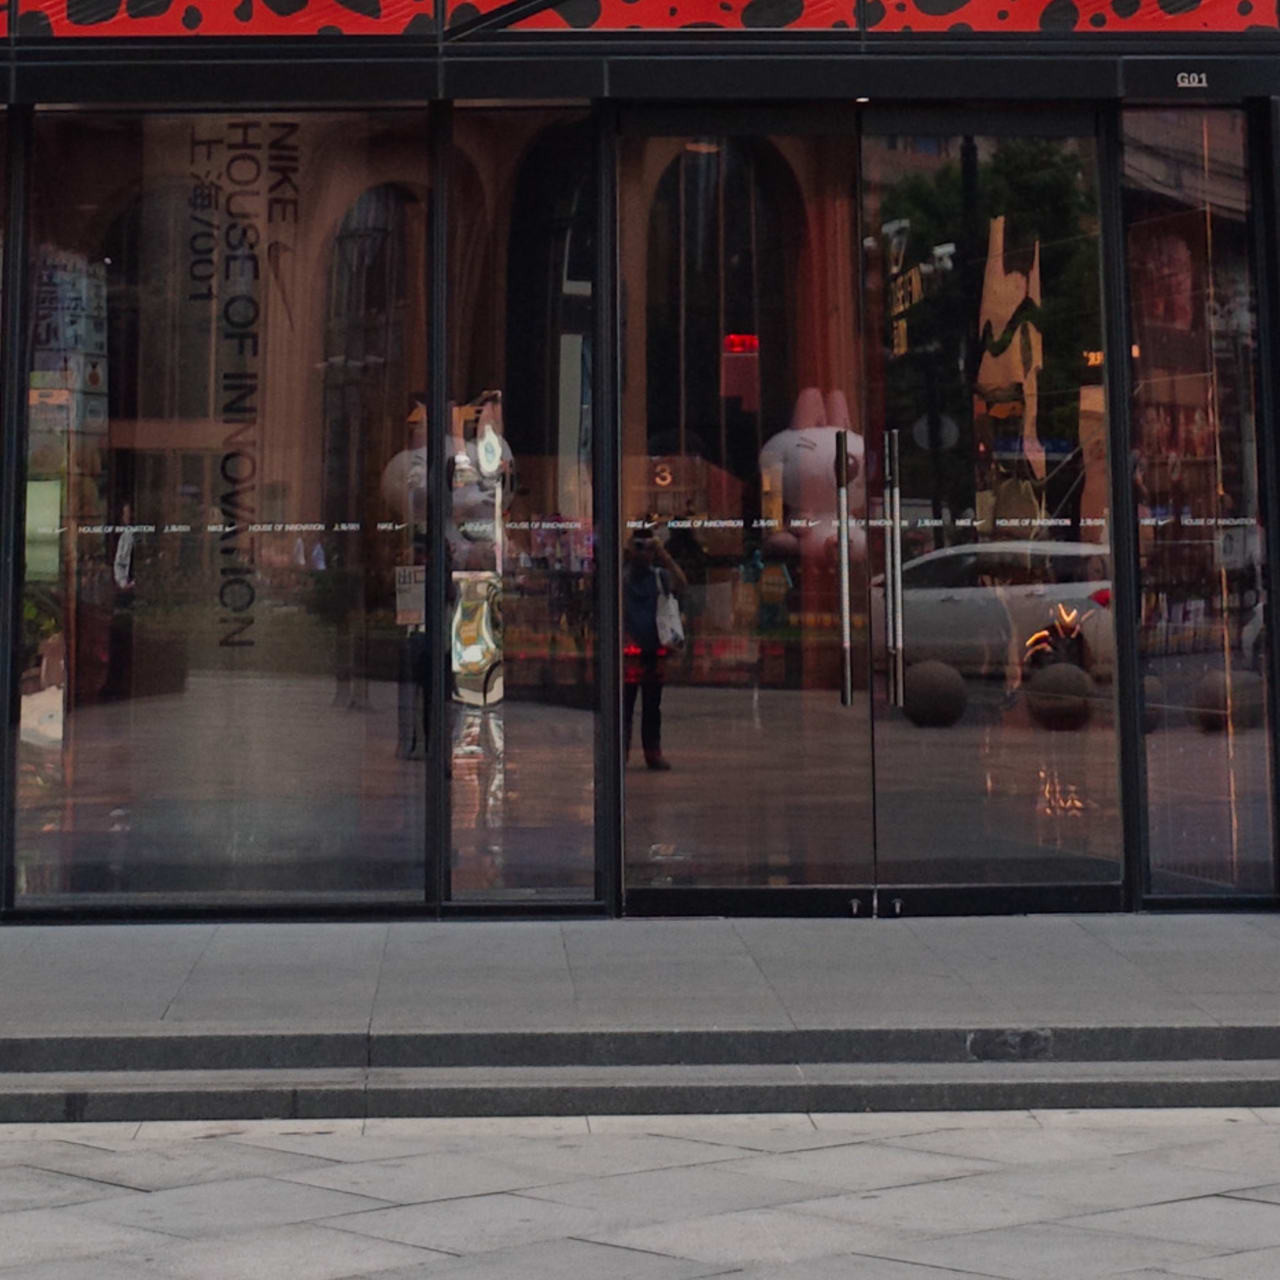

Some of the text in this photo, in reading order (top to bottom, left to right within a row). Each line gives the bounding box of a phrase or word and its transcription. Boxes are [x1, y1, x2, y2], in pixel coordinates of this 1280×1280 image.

[1176, 72, 1208, 88] G01
[188, 125, 223, 301] 上海/001
[268, 122, 299, 223] NIKE
[219, 122, 261, 647] HOUSE OF INNOVATION
